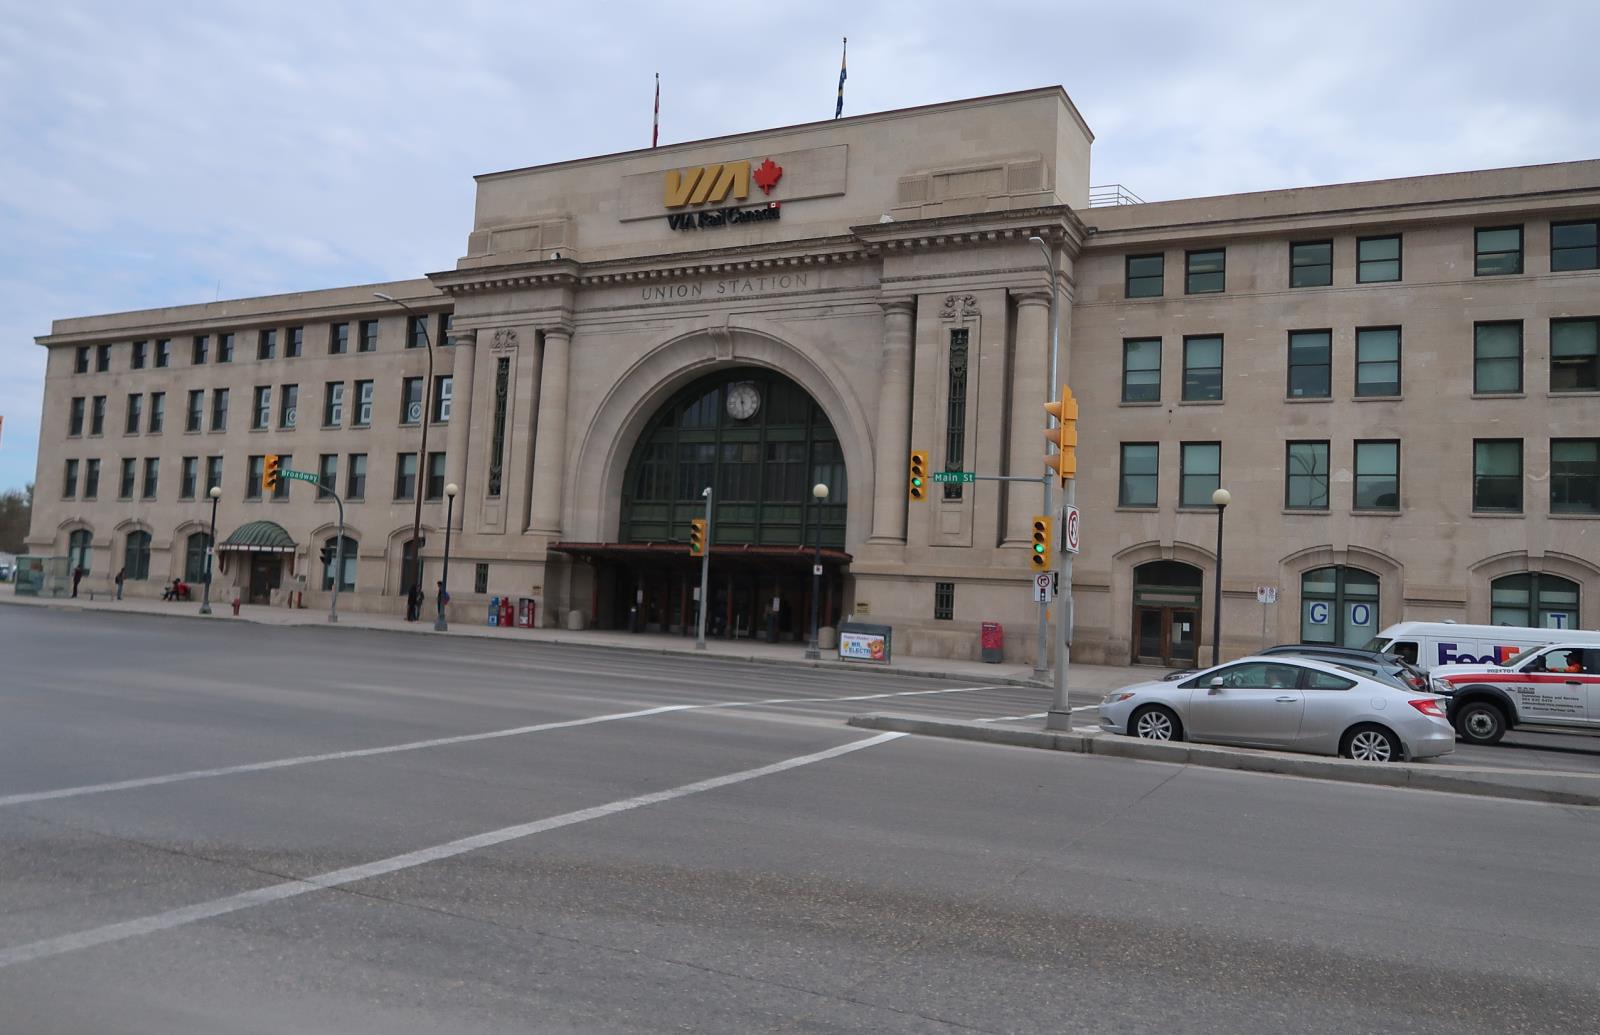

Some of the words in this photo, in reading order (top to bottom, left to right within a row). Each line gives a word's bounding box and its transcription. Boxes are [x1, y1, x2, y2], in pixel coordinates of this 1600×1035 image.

[664, 160, 750, 208] VIA
[667, 211, 697, 231] VIA
[698, 207, 727, 229] Rail
[727, 206, 780, 225] Canada
[642, 283, 702, 300] UNION
[717, 273, 807, 294] STATION
[282, 470, 317, 482] Broadway
[935, 473, 958, 482] Main
[963, 473, 973, 482] St
[1438, 643, 1519, 666] FedE
